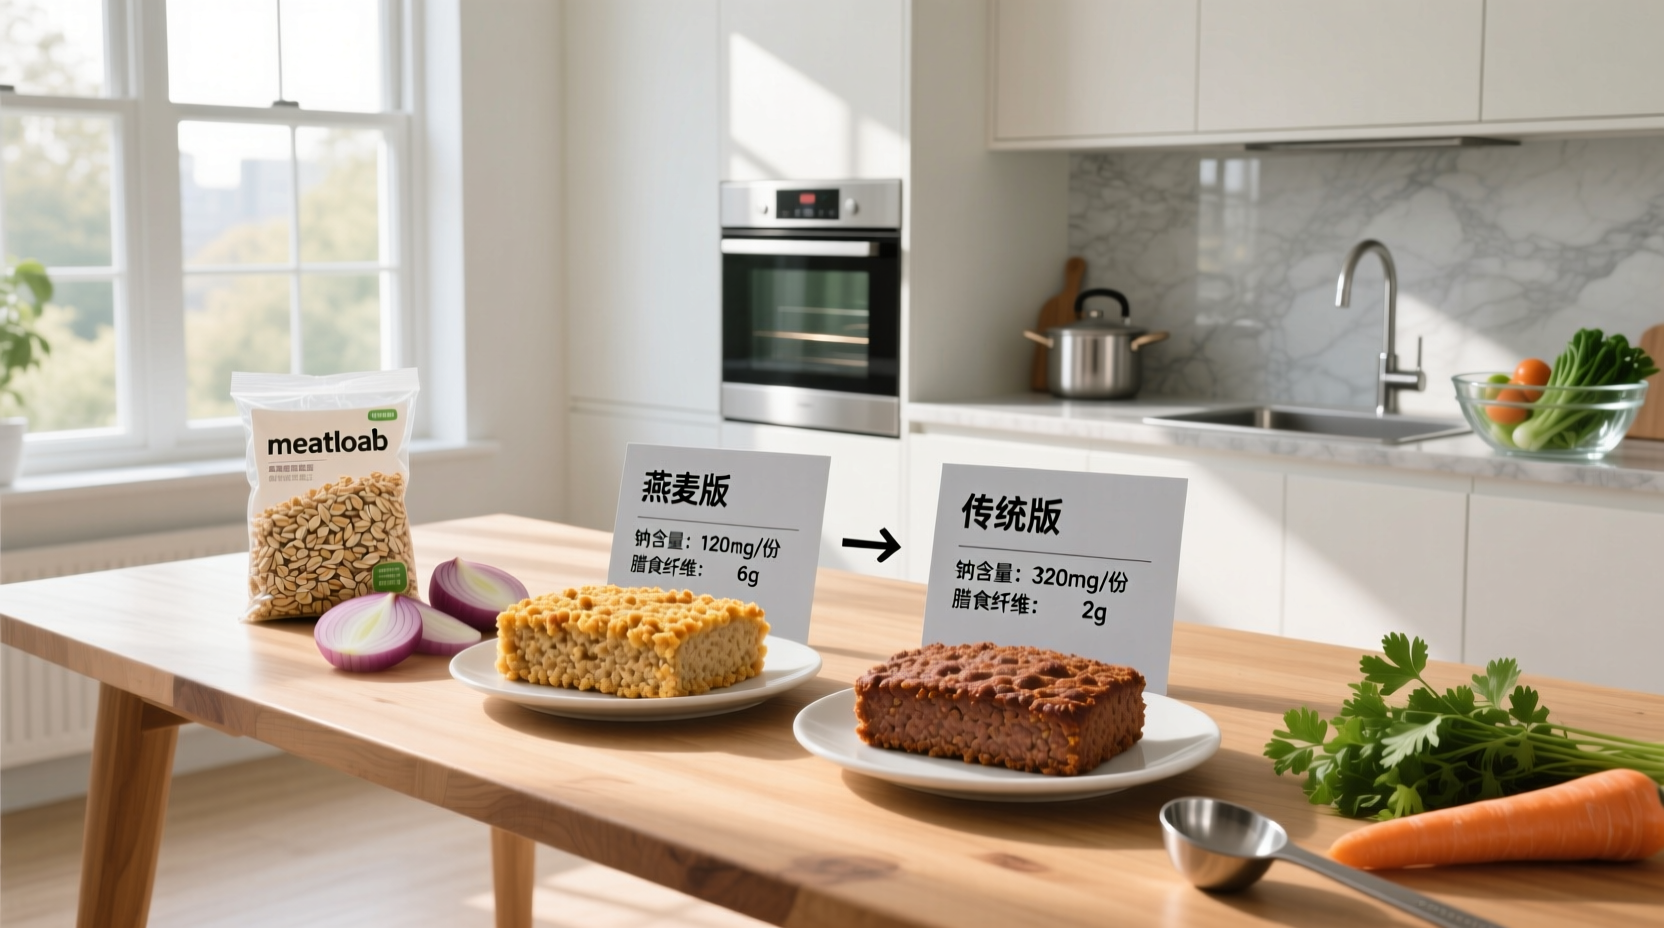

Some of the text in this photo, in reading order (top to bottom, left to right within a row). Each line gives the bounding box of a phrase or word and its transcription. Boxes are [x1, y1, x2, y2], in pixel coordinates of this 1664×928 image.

[267, 427, 389, 456] meatloab
[641, 469, 731, 508] 燕麦版
[961, 492, 1063, 536] 传统版
[736, 565, 760, 588] 6g
[1081, 600, 1107, 627] 2g
